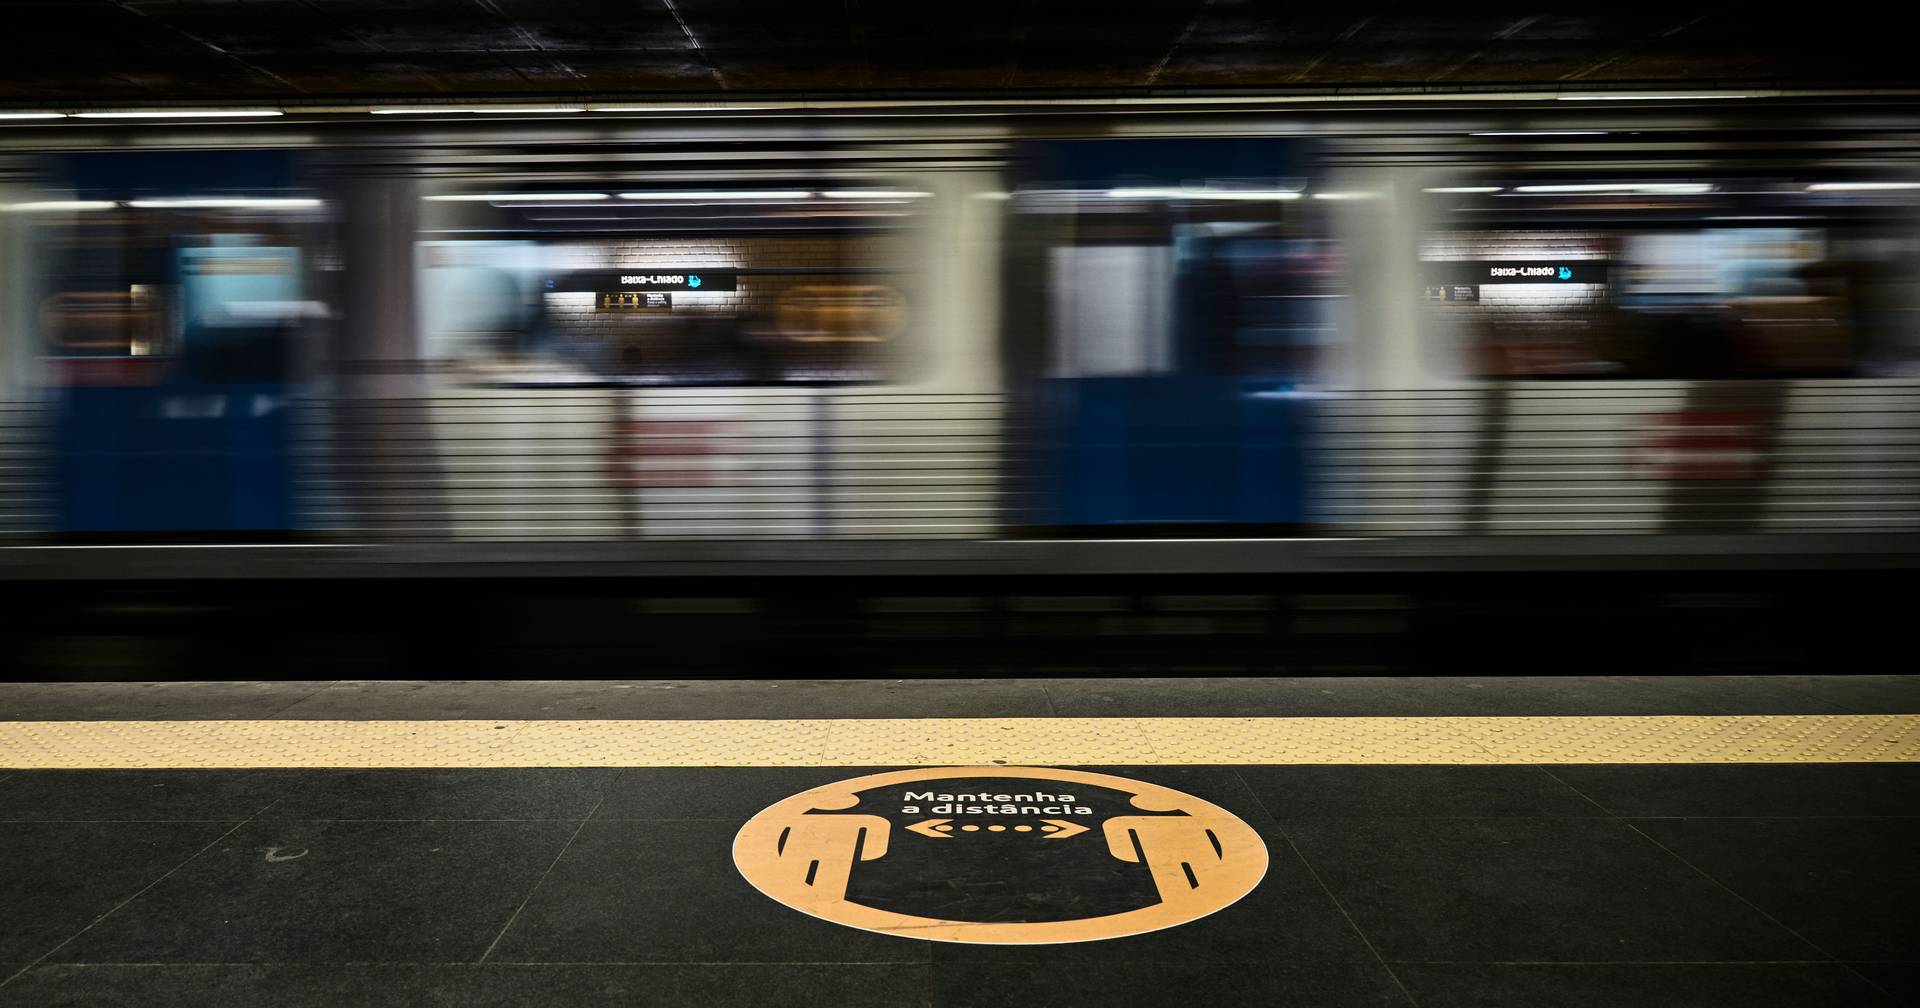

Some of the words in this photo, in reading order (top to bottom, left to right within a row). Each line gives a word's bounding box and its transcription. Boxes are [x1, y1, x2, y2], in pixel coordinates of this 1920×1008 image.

[903, 791, 1076, 802] Mantenha
[901, 804, 920, 814] a
[931, 803, 1093, 815] distância
